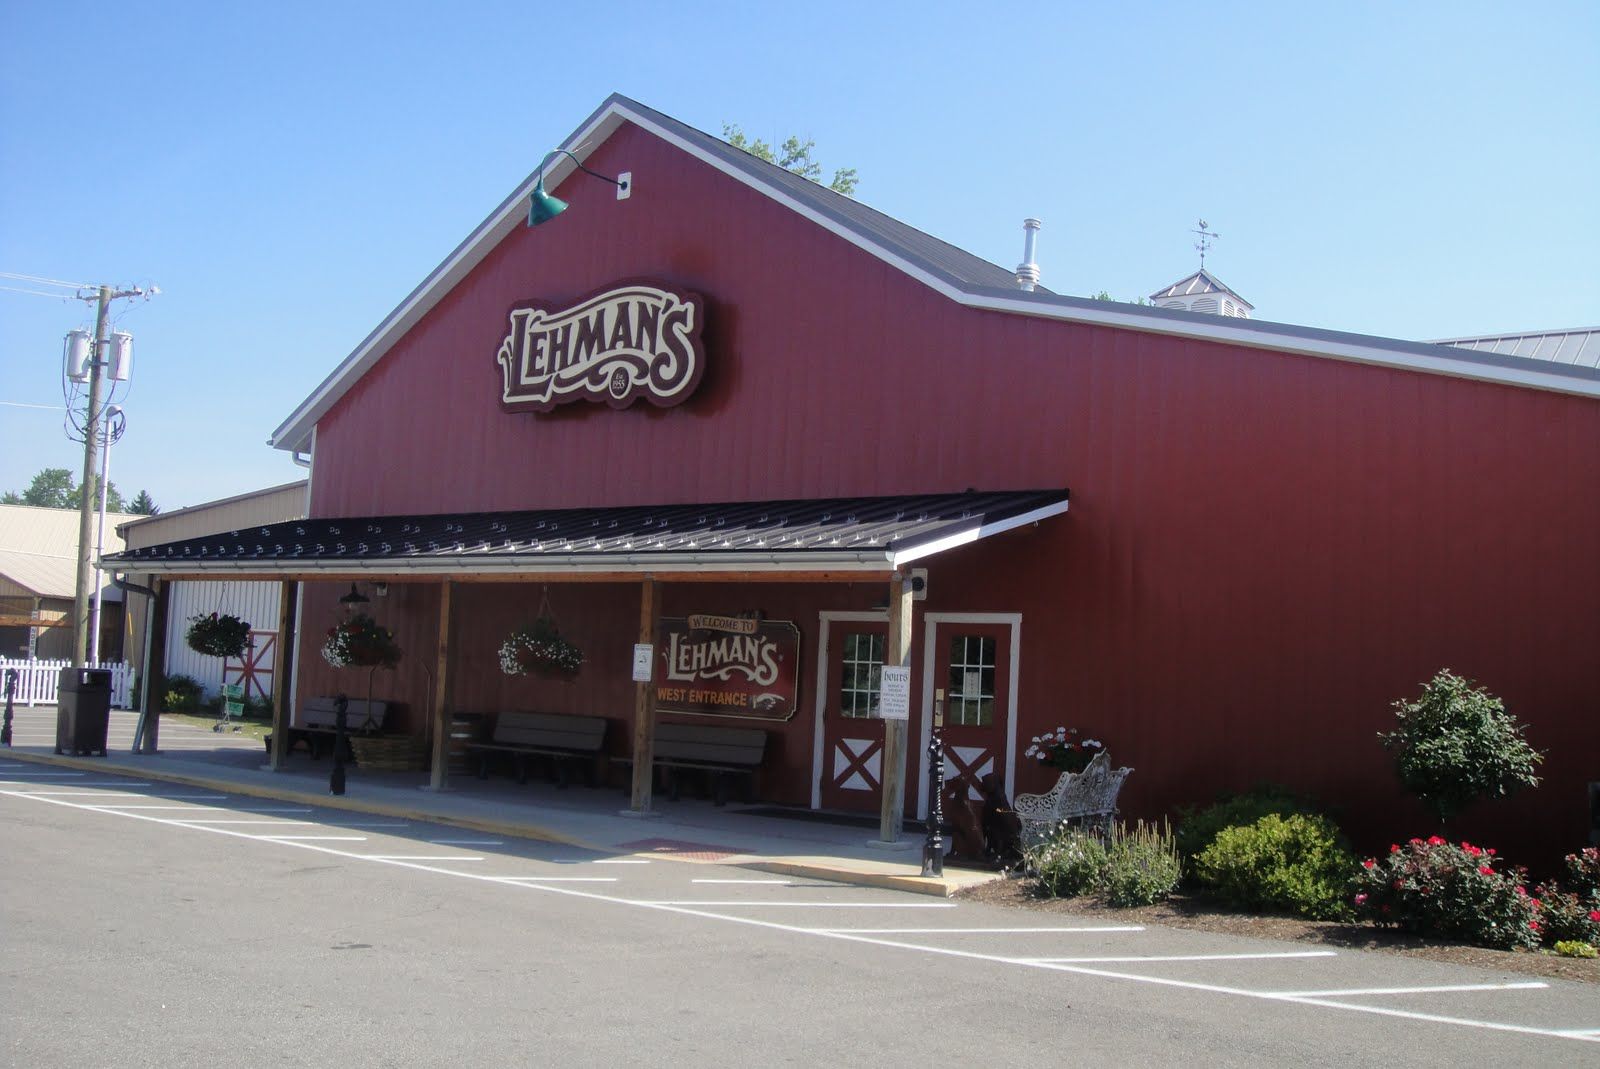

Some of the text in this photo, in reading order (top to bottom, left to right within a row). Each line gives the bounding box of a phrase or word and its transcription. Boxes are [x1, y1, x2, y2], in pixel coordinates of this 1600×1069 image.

[499, 291, 692, 401] LEHMAN'S
[612, 379, 625, 389] 1955
[692, 615, 754, 632] WELCOME TO
[661, 632, 779, 686] LEHMAN'S
[884, 670, 908, 682] hours
[657, 687, 747, 706] WEST ENTRANCE
